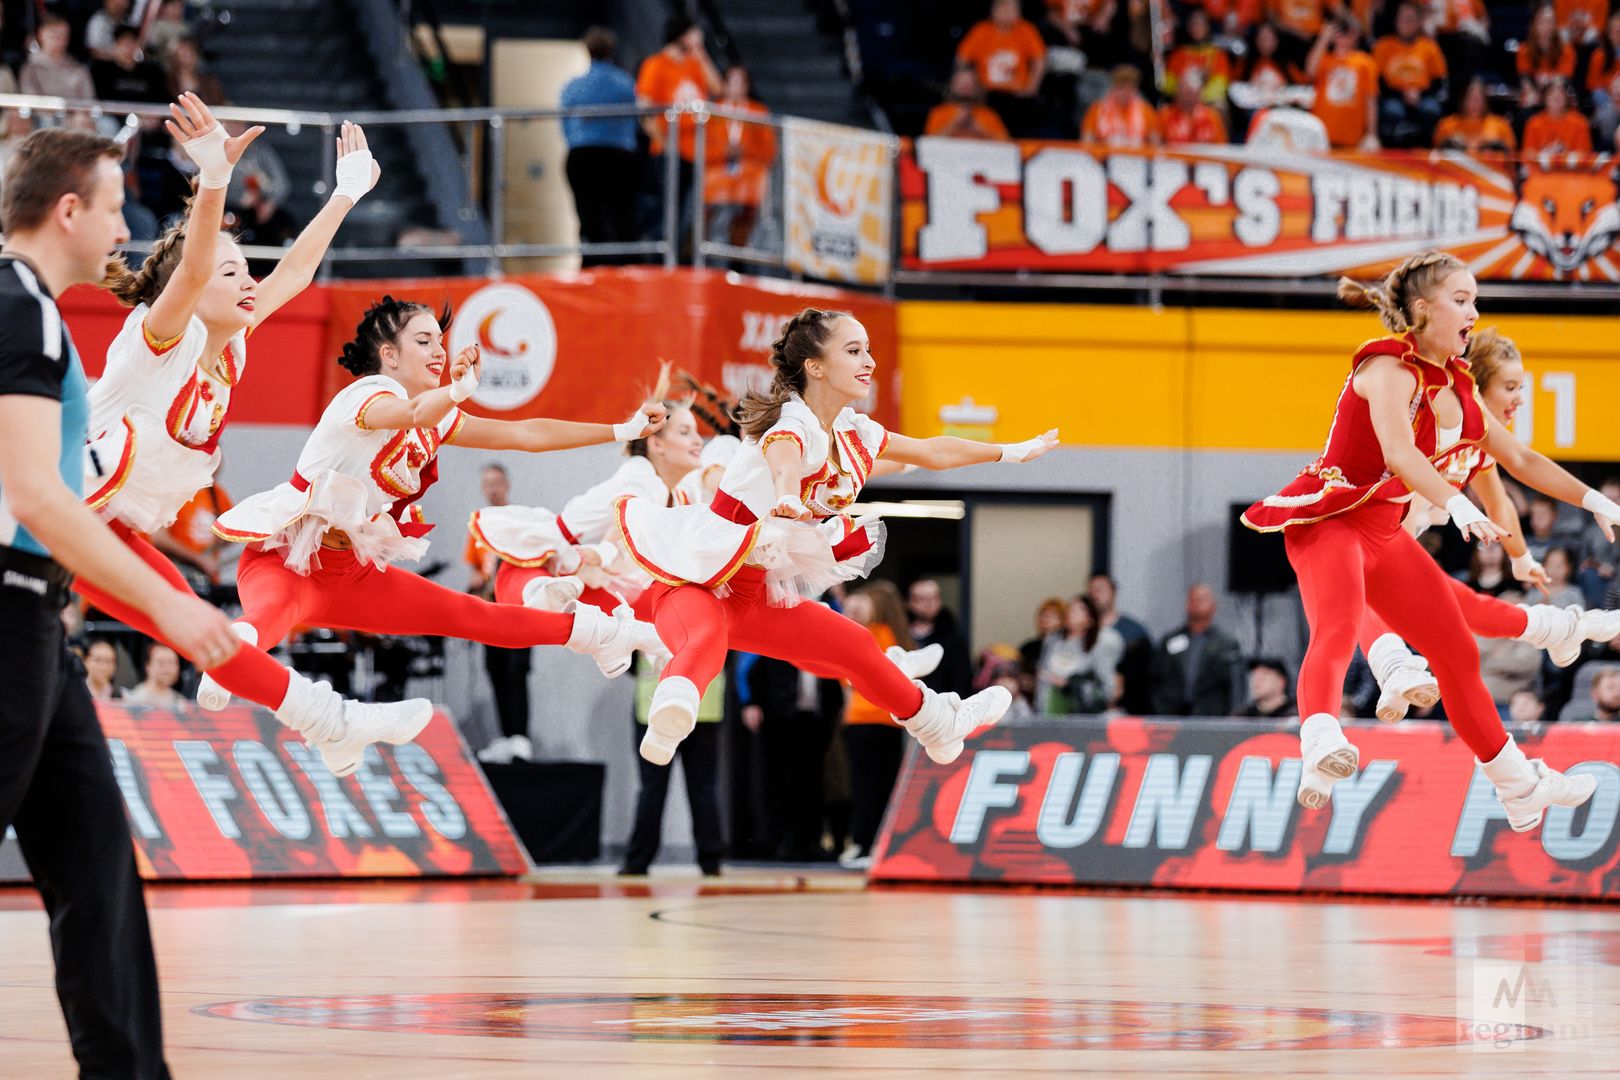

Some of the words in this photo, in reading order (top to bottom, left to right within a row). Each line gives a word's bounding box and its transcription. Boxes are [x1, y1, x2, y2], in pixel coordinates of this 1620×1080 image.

[916, 138, 1280, 262] FOX'S
[1311, 170, 1479, 243] FRIENDS
[172, 739, 467, 840] FOXES
[949, 750, 1398, 854] FUNNY
